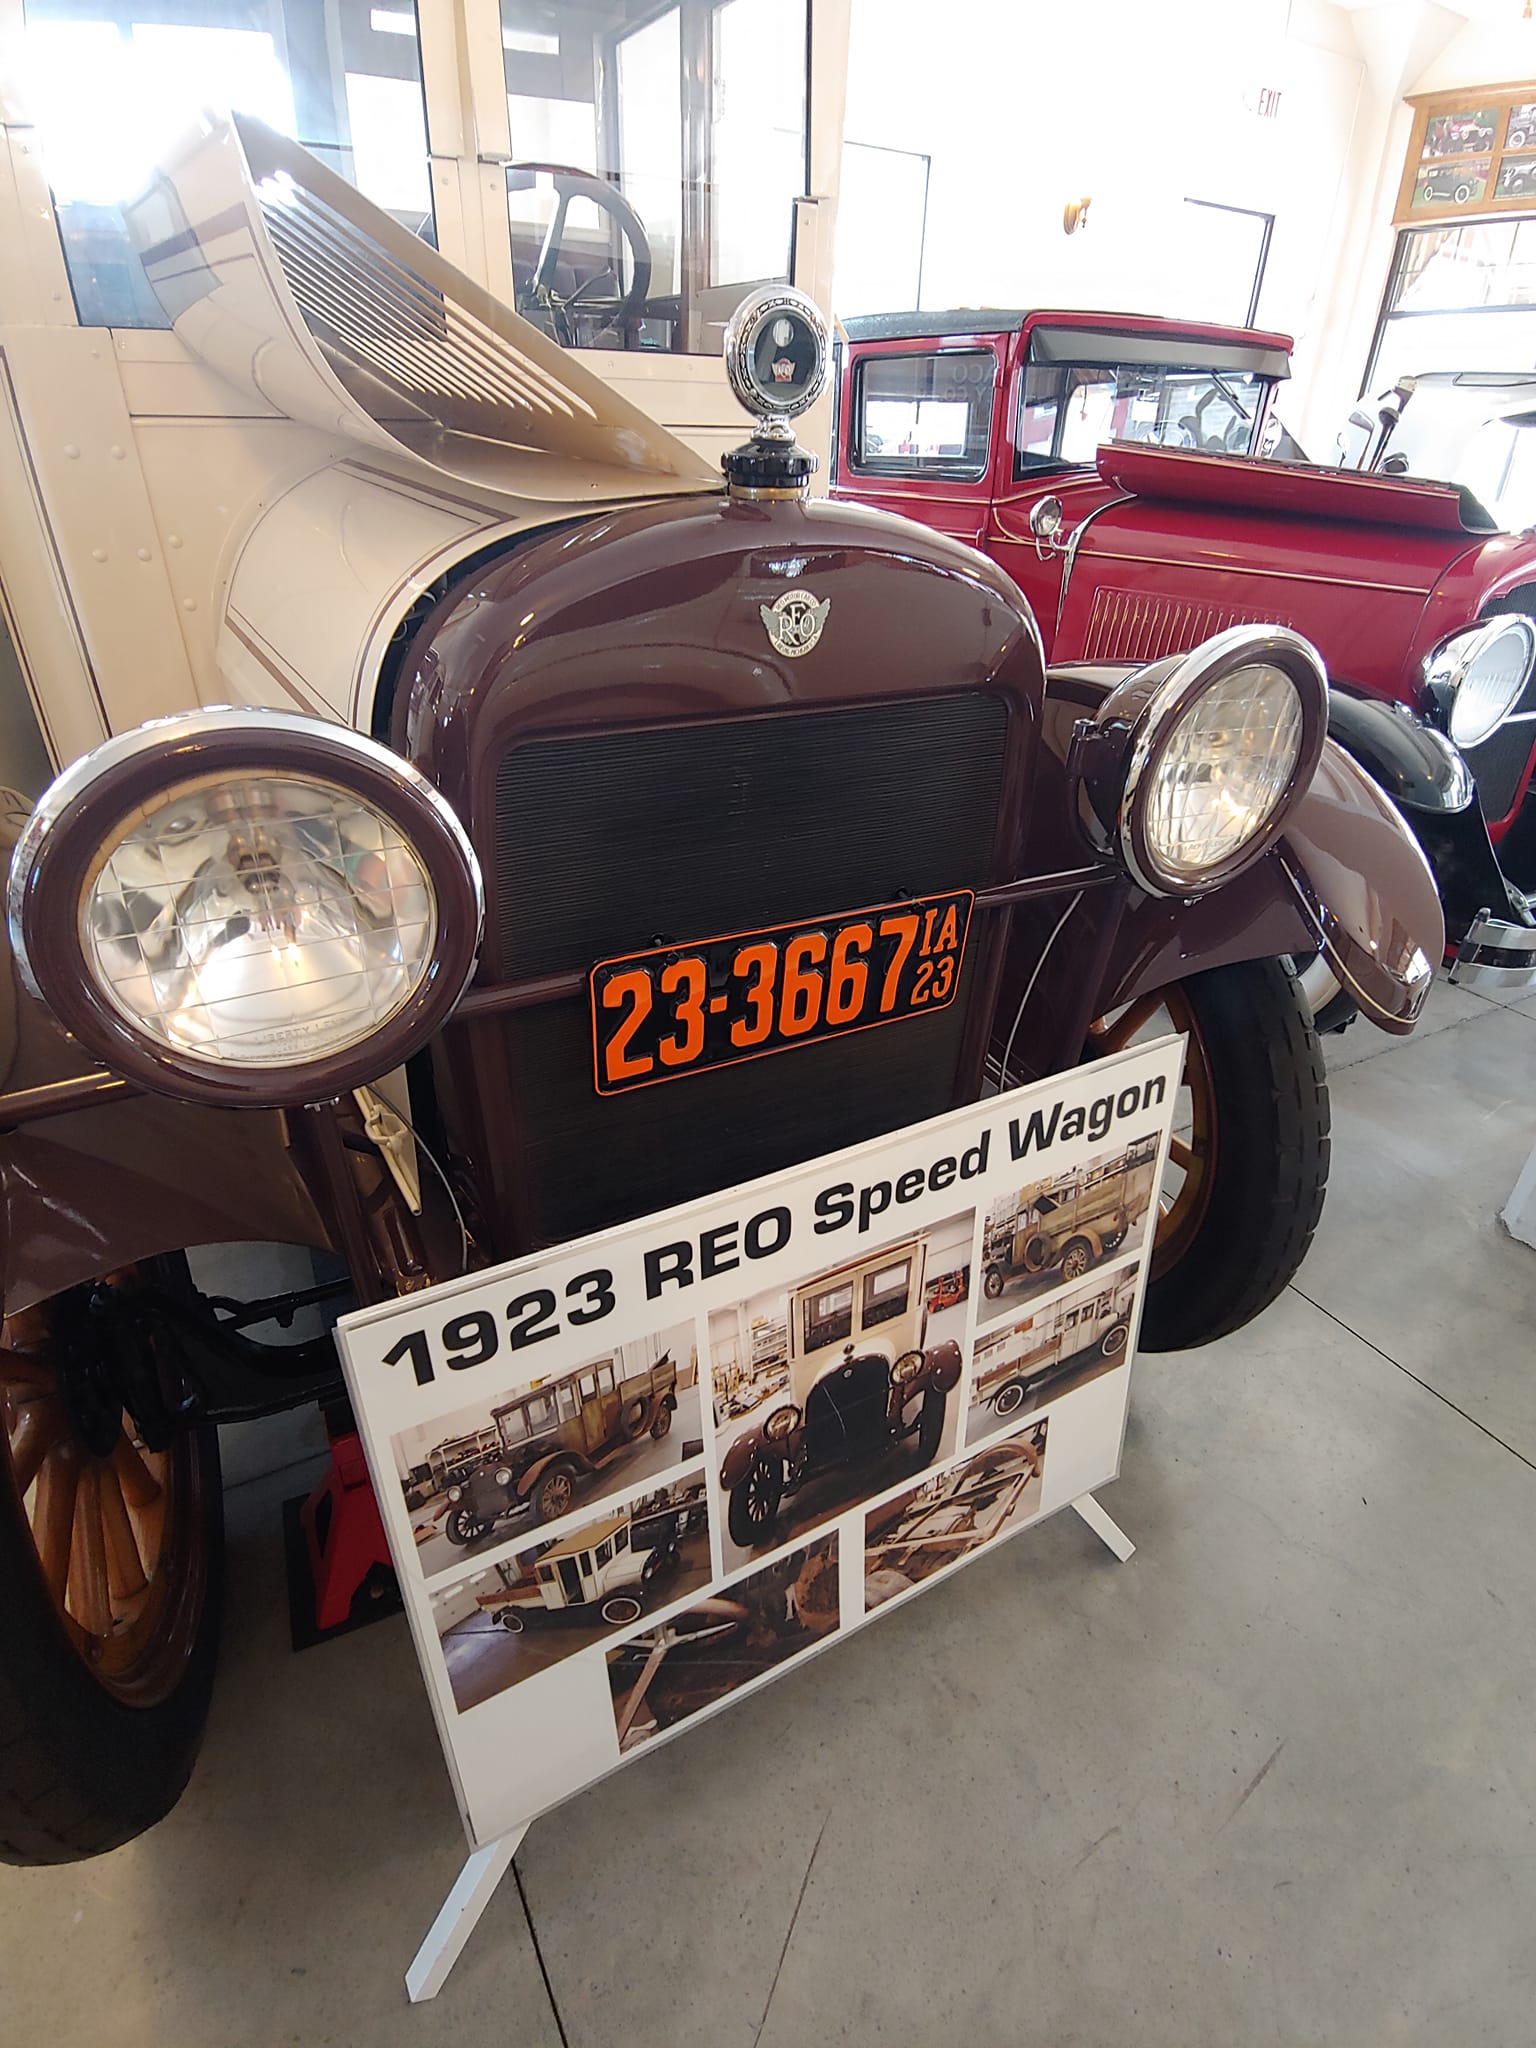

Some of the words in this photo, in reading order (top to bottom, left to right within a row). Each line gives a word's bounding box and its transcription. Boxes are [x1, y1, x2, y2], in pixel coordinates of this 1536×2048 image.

[1258, 88, 1282, 119] EXIT
[779, 602, 816, 646] REO
[919, 905, 957, 957] IA
[603, 915, 920, 1081] 23-3667
[910, 956, 954, 1005] 23
[382, 1268, 616, 1386] 1923
[643, 1206, 792, 1301] REO
[813, 1129, 991, 1235] Speed
[1008, 1075, 1166, 1162] Wagon
